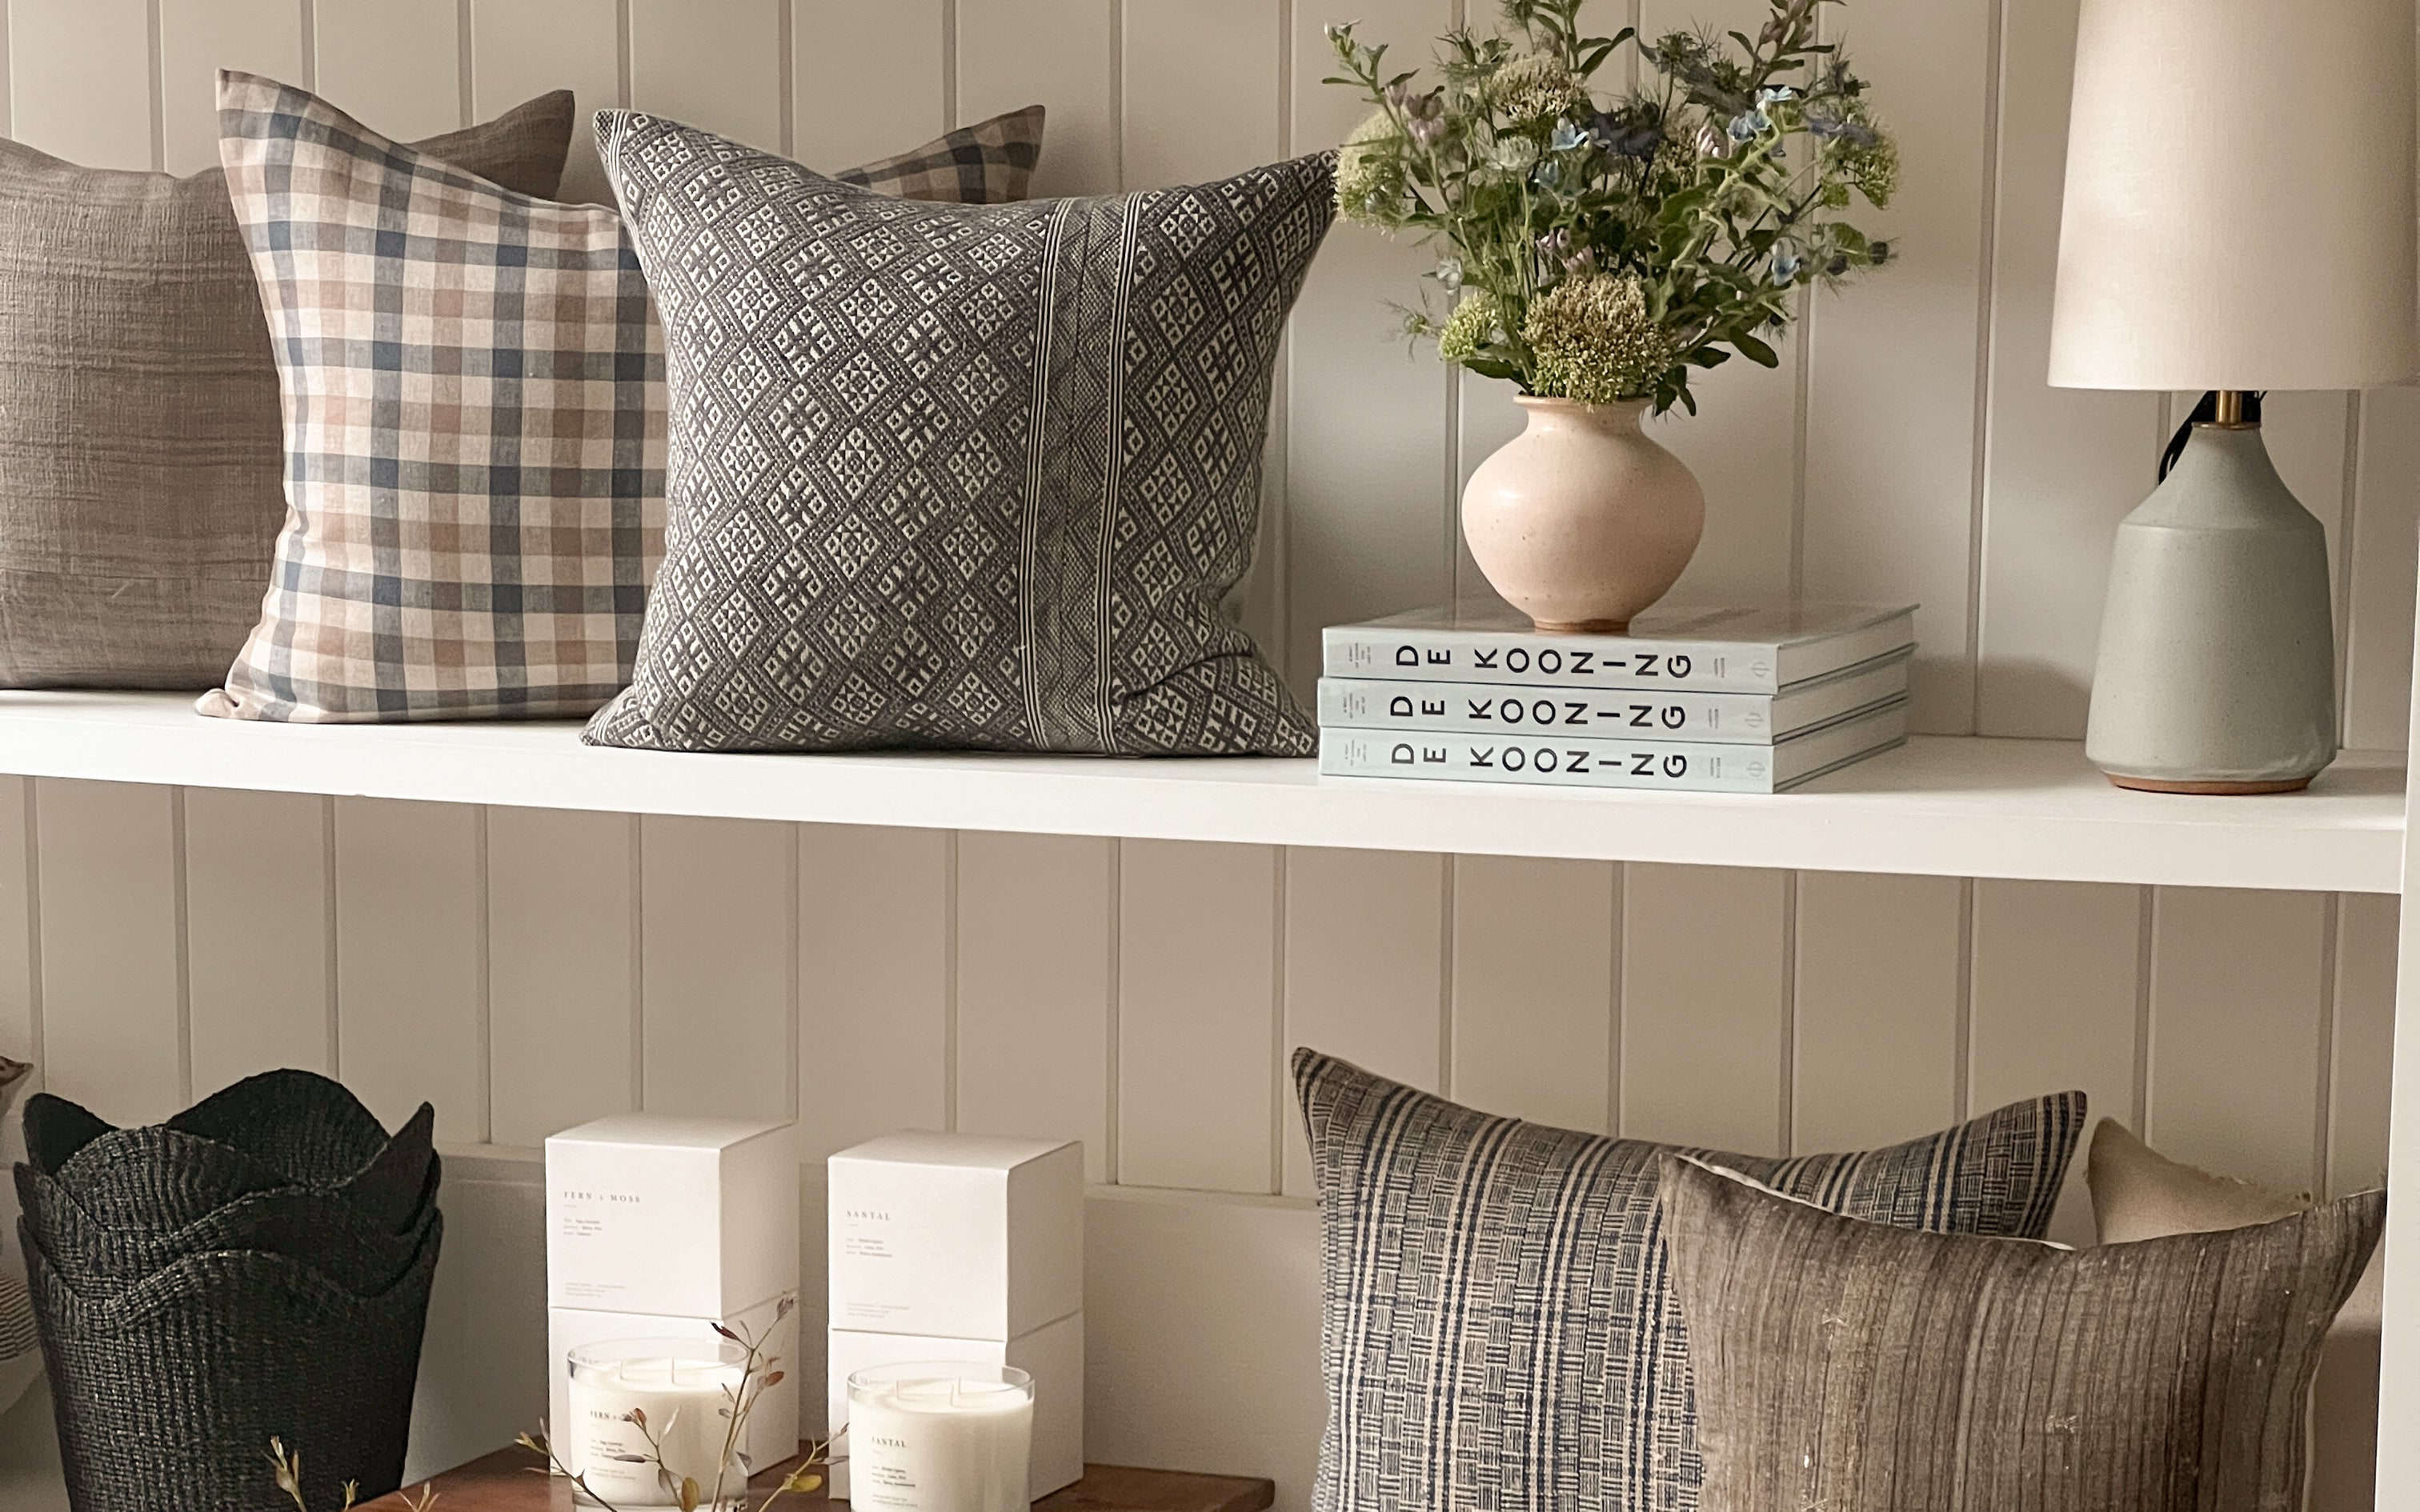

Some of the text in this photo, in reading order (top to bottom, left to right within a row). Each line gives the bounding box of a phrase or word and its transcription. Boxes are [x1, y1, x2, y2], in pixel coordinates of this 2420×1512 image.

[1396, 645, 1451, 667] DE
[1474, 647, 1692, 678] KOONING
[1389, 695, 1445, 718] DE
[1468, 698, 1686, 730] KOONING
[1391, 743, 1447, 765] DE
[1469, 746, 1688, 778] KOONING
[563, 1190, 592, 1200] FERN
[610, 1194, 640, 1203] MOSS
[847, 1210, 891, 1221] SANTAL
[590, 1410, 611, 1421] FERN
[871, 1436, 907, 1448] SANTAL
